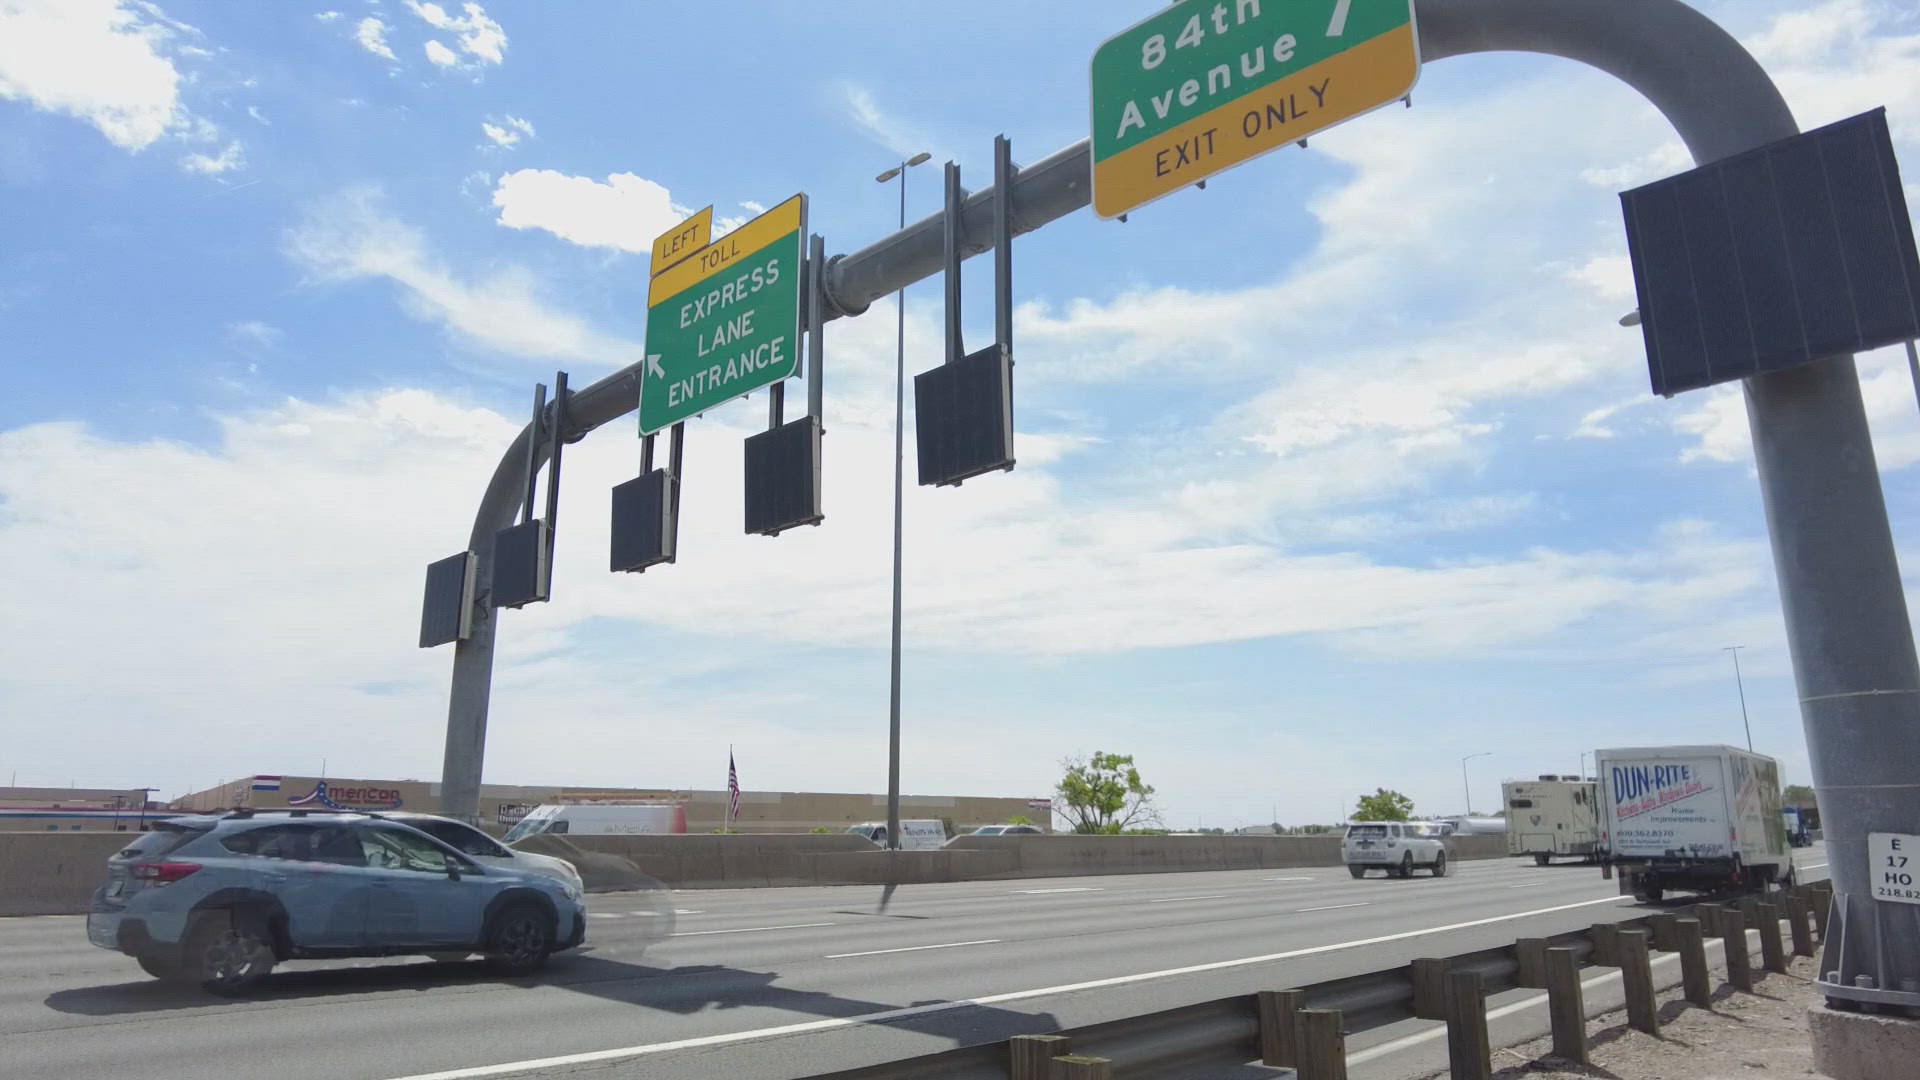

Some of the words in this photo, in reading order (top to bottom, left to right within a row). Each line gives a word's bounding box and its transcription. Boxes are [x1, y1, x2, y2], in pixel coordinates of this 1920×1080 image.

[1141, 0, 1262, 71] 84th
[1117, 33, 1297, 139] Avenue
[1156, 128, 1217, 177] EXIT
[1242, 78, 1330, 138] ONLY
[662, 224, 699, 259] LEFT
[701, 240, 740, 273] TOLL
[680, 259, 779, 328] EXPRESS
[698, 310, 755, 357] LANE
[668, 336, 784, 408] ENTRANCE
[1613, 765, 1690, 804] DUN-RITE
[1887, 855, 1908, 868] 17
[1891, 839, 1901, 851] E
[1879, 887, 1920, 899] 218.82
[1885, 872, 1912, 886] HO
